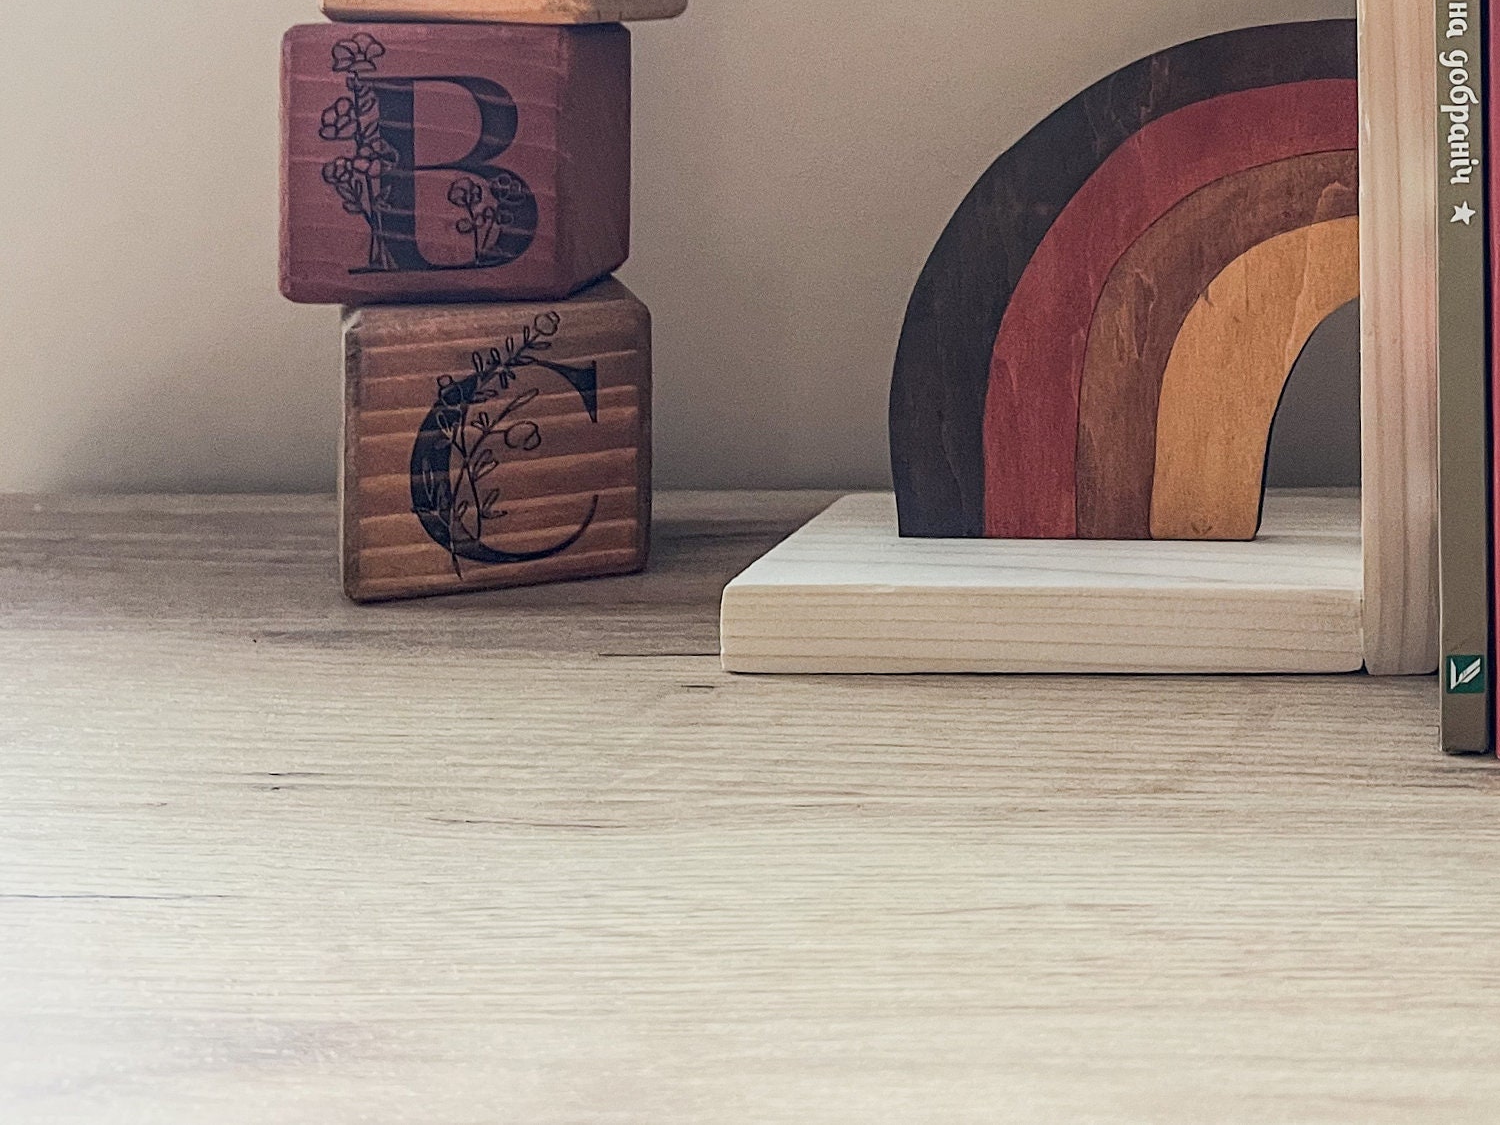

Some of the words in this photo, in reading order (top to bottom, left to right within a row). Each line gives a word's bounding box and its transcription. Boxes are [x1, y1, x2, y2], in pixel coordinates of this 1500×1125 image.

[1445, 1, 1468, 38] на
[340, 73, 541, 274] B
[1438, 49, 1480, 185] добраніч
[410, 351, 600, 565] C
